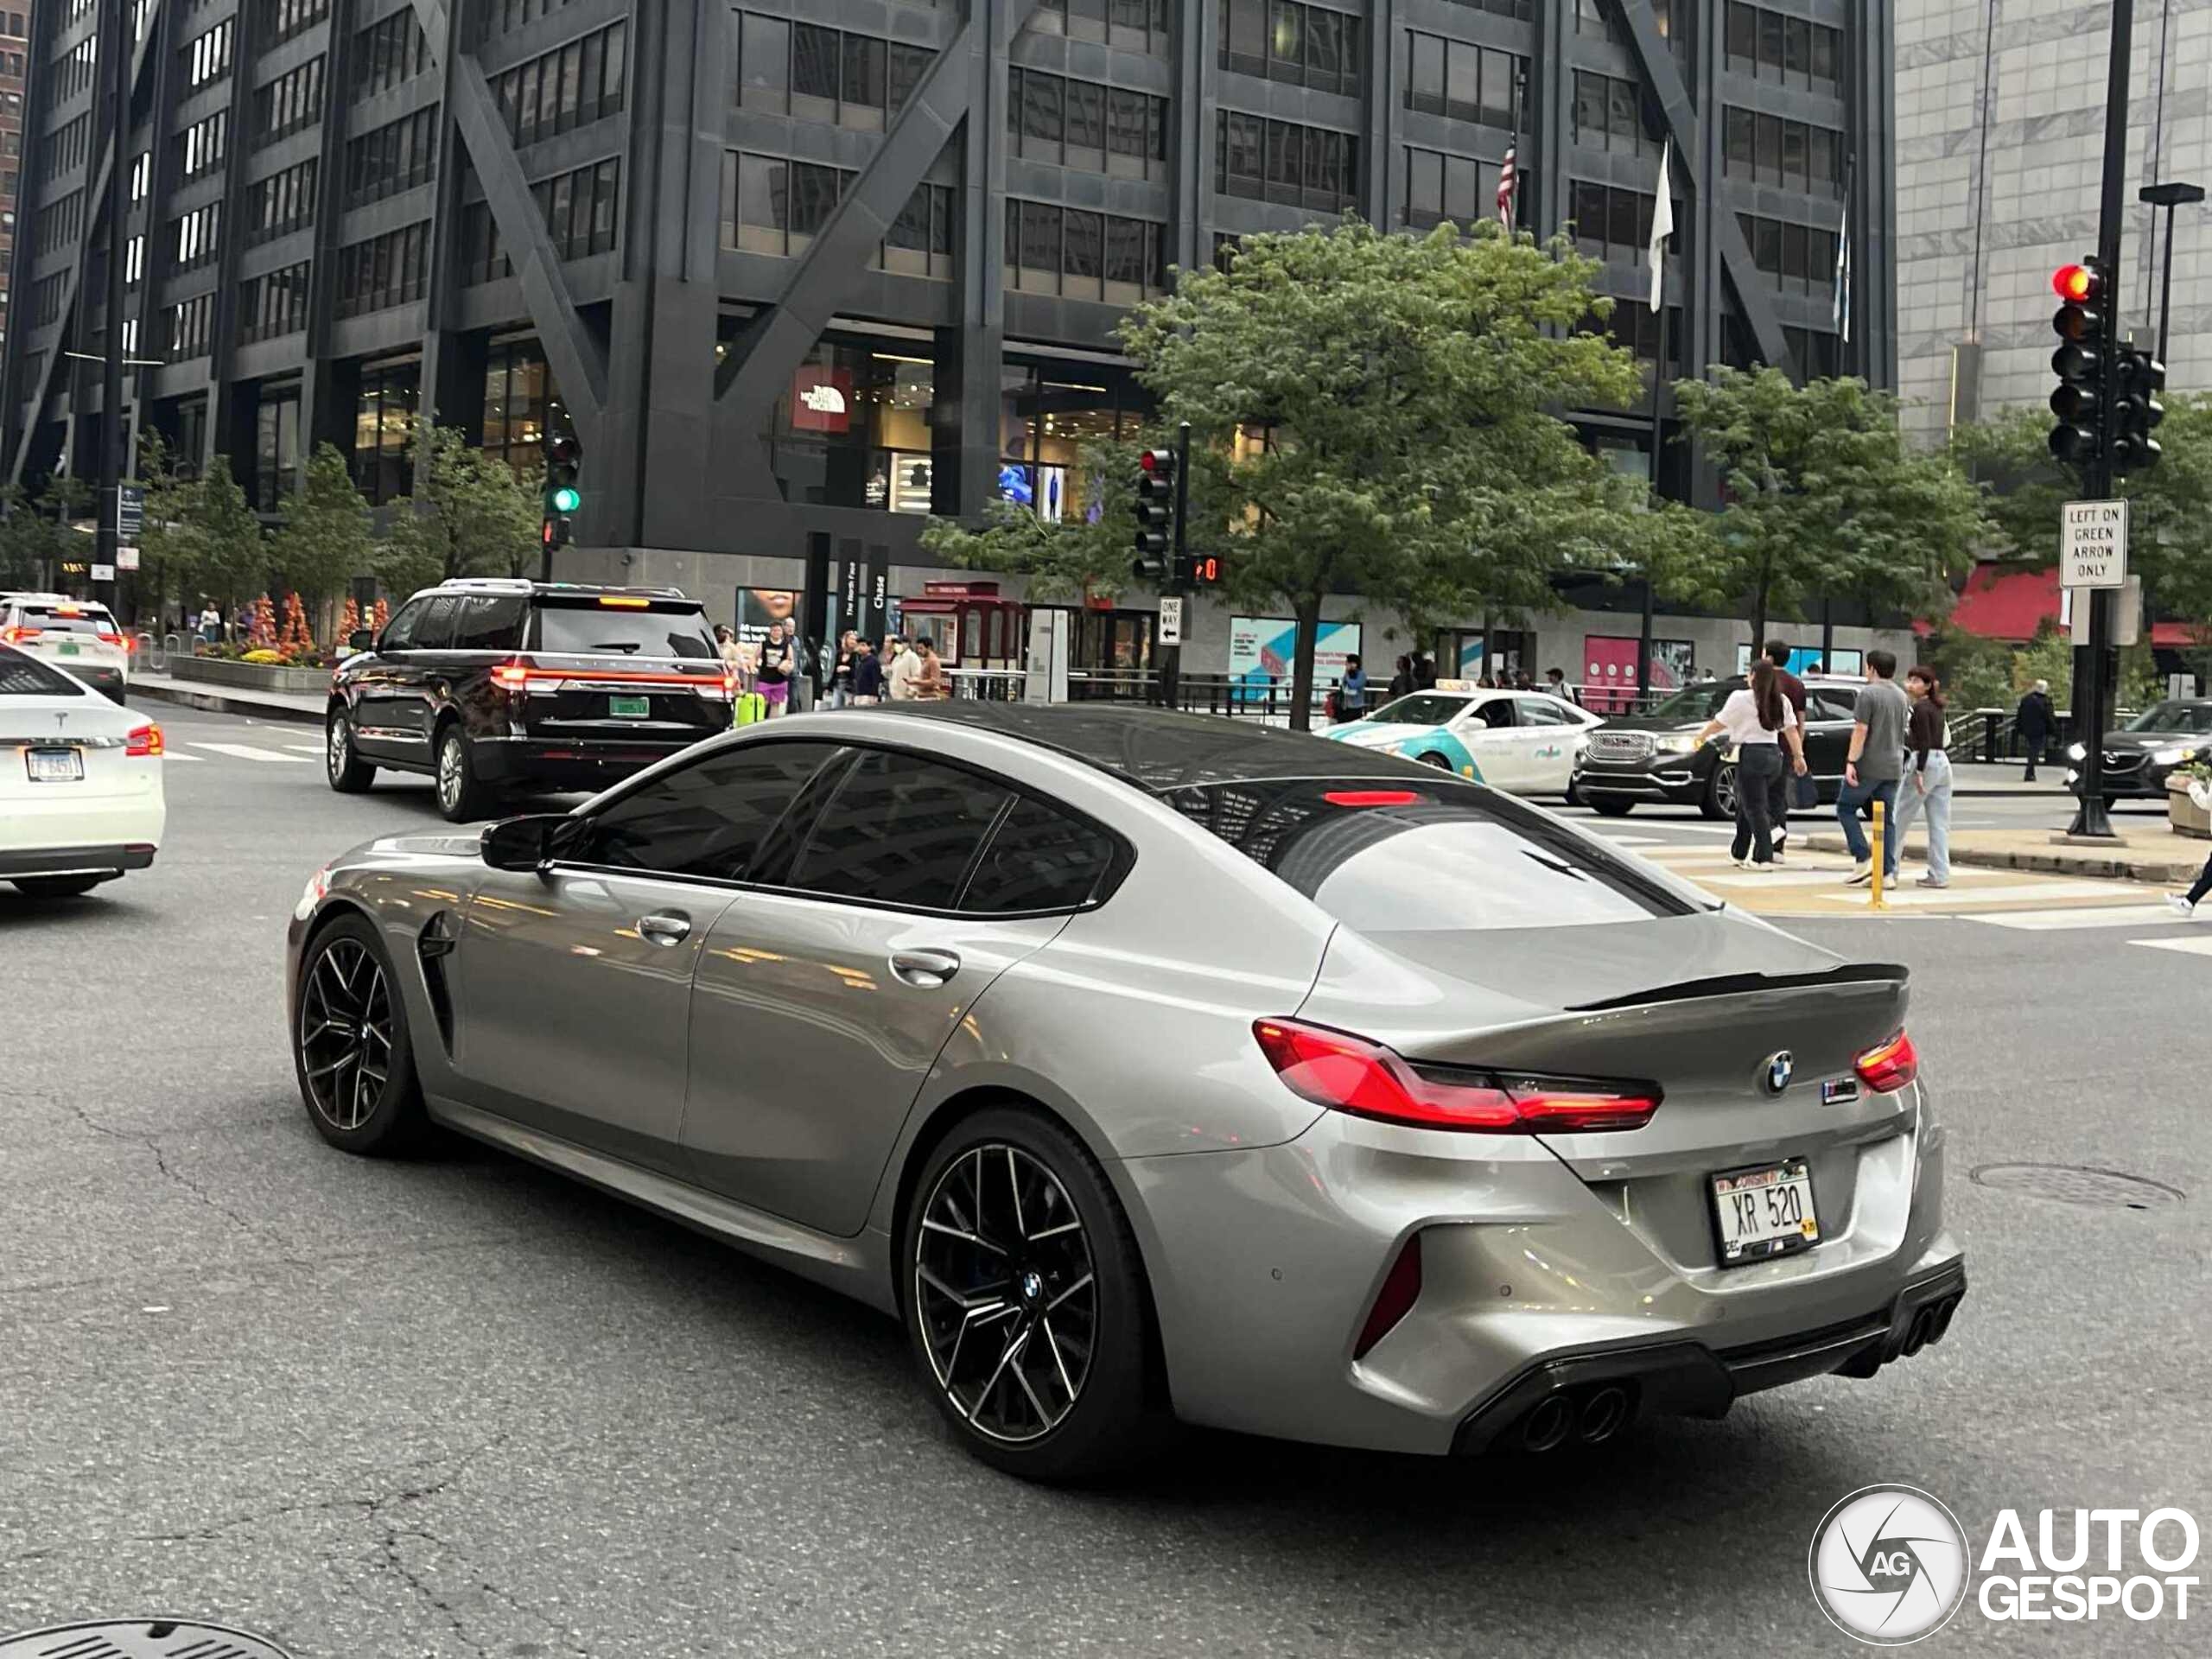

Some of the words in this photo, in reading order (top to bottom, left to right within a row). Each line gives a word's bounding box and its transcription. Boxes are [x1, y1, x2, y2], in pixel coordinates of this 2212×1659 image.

[2070, 509, 2096, 524] LEFT
[2103, 508, 2119, 522] ON
[2075, 527, 2113, 541] GREEN
[2074, 545, 2113, 559] ARROW
[2078, 563, 2107, 577] ONLY
[874, 575, 885, 609] Chase
[1162, 601, 1179, 613] ONE
[1162, 614, 1177, 625] WAY
[1732, 1192, 1759, 1236] XR
[1765, 1185, 1802, 1227] 520
